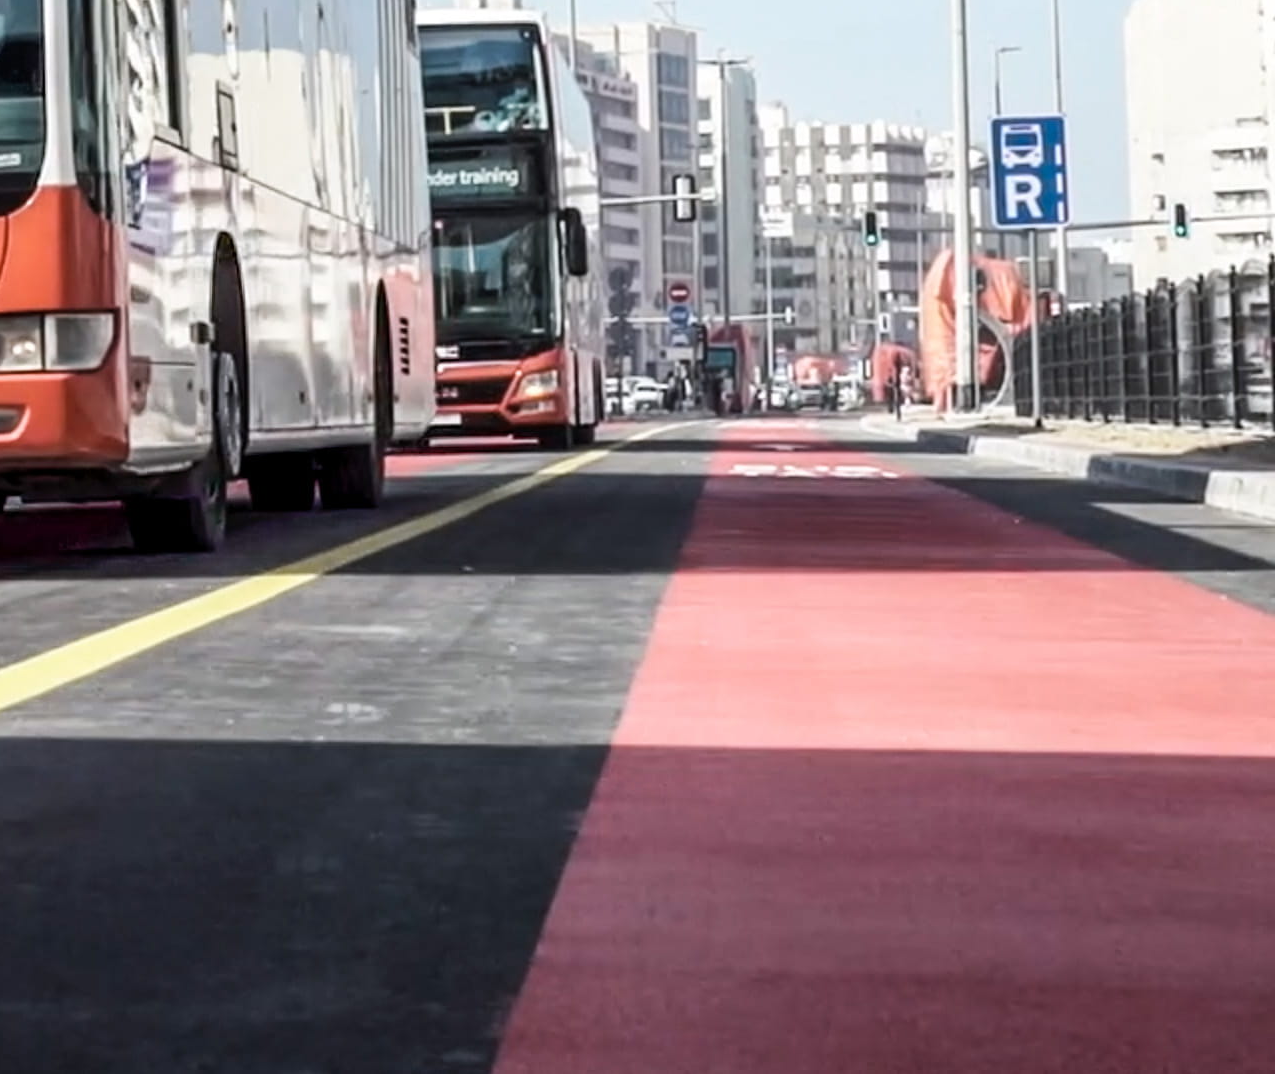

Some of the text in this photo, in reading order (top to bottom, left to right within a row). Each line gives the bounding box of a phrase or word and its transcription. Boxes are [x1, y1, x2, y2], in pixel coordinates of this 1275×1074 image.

[427, 166, 519, 188] nder training
[1005, 174, 1043, 218] R
